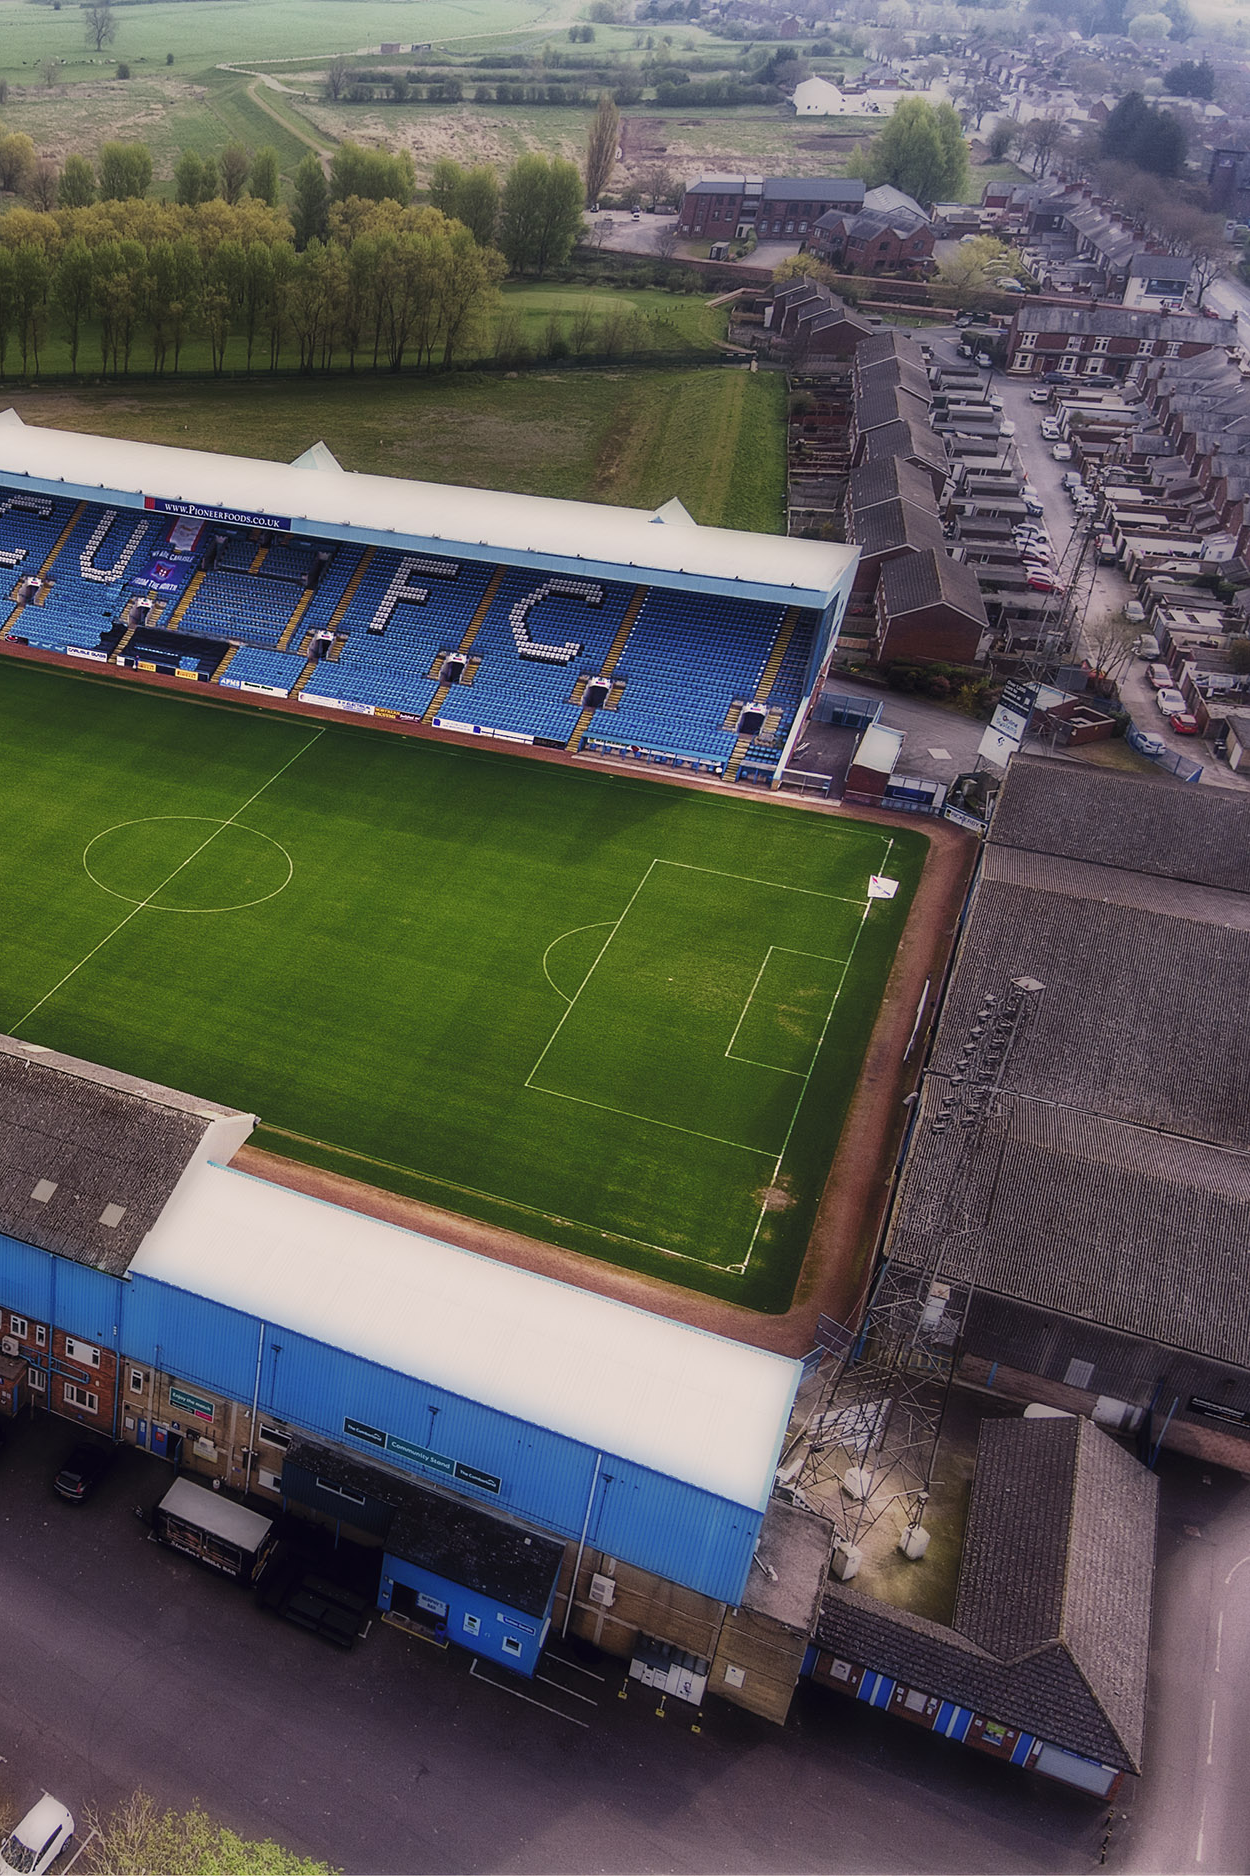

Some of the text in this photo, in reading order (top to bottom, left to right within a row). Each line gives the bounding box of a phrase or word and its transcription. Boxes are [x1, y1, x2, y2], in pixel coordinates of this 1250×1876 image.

[169, 553, 195, 563] CARLISLE
[80, 510, 149, 583] U
[370, 557, 460, 633] F
[508, 578, 603, 661] C
[67, 646, 107, 659] CARLISLE GLASS
[172, 1392, 186, 1402] Enjoy
[186, 1396, 195, 1406] the
[195, 1400, 211, 1412] match
[391, 1441, 450, 1470] Community Stand
